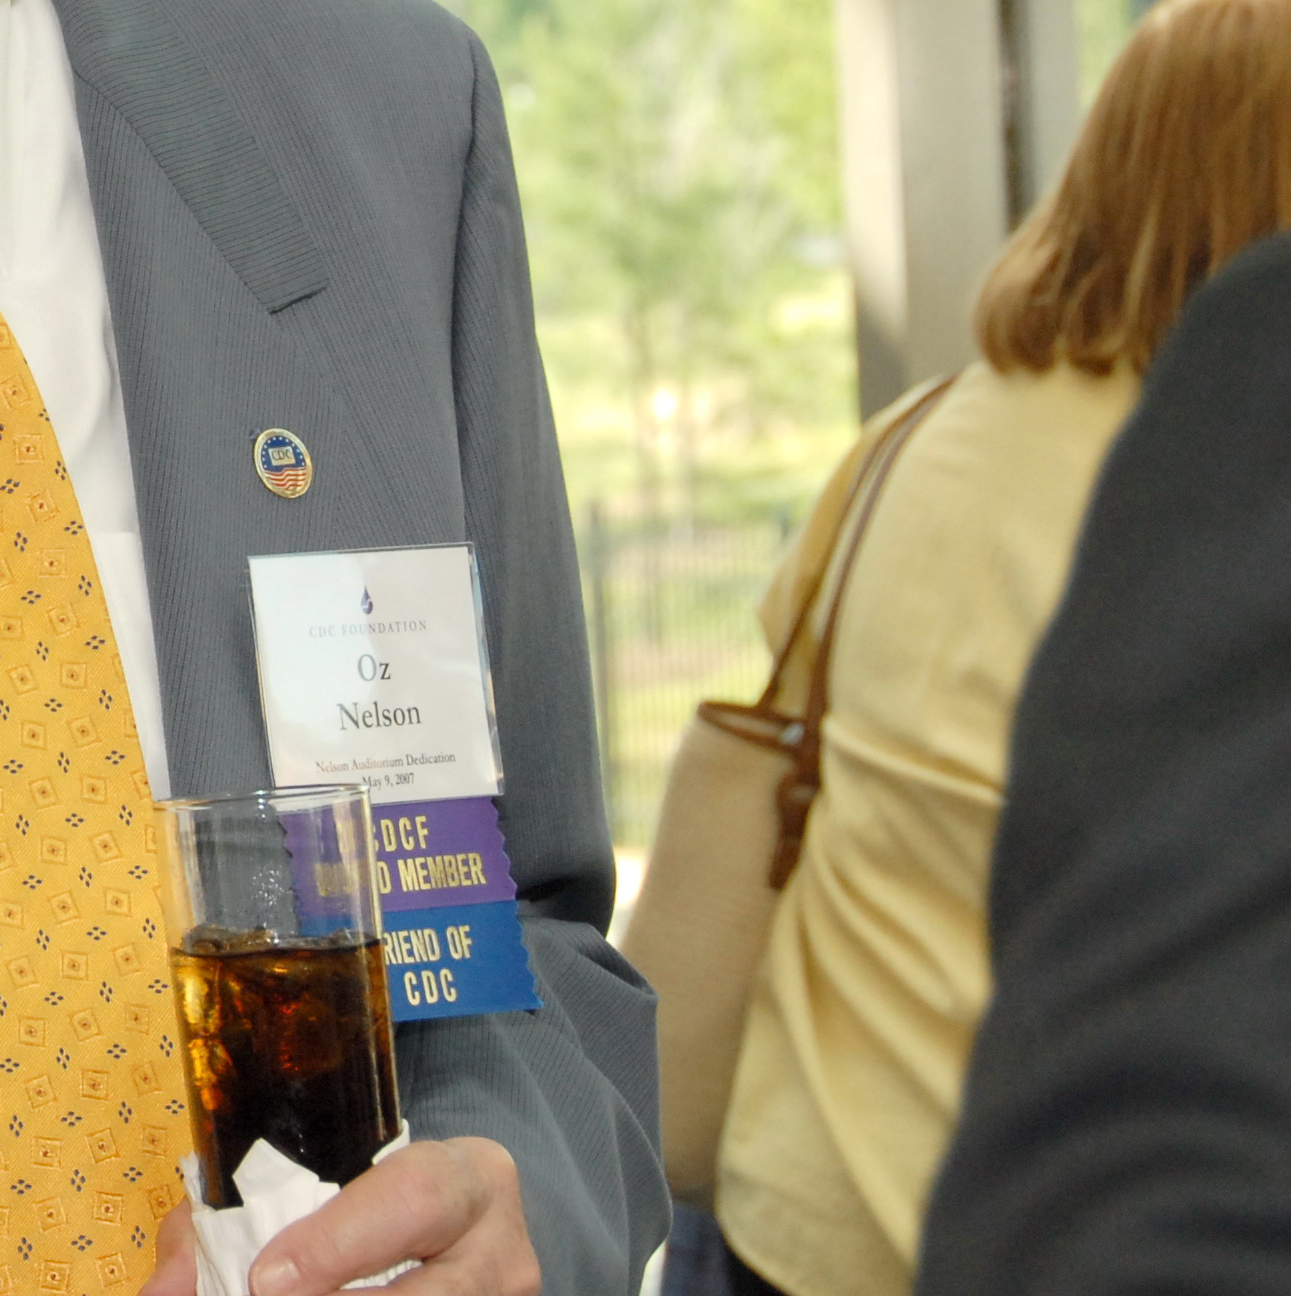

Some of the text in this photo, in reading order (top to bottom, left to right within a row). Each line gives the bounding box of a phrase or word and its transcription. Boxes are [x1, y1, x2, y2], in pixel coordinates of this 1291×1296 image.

[309, 620, 427, 638] CDC FOUNDATION
[357, 653, 391, 681] Oz
[336, 701, 421, 731] Nelson
[315, 751, 456, 773] Nelson Auditorium Dedication
[362, 772, 415, 791] May 9, 2007
[397, 852, 486, 892] MEMBER
[383, 925, 473, 965] RIEND OF
[404, 968, 457, 1006] CDC
